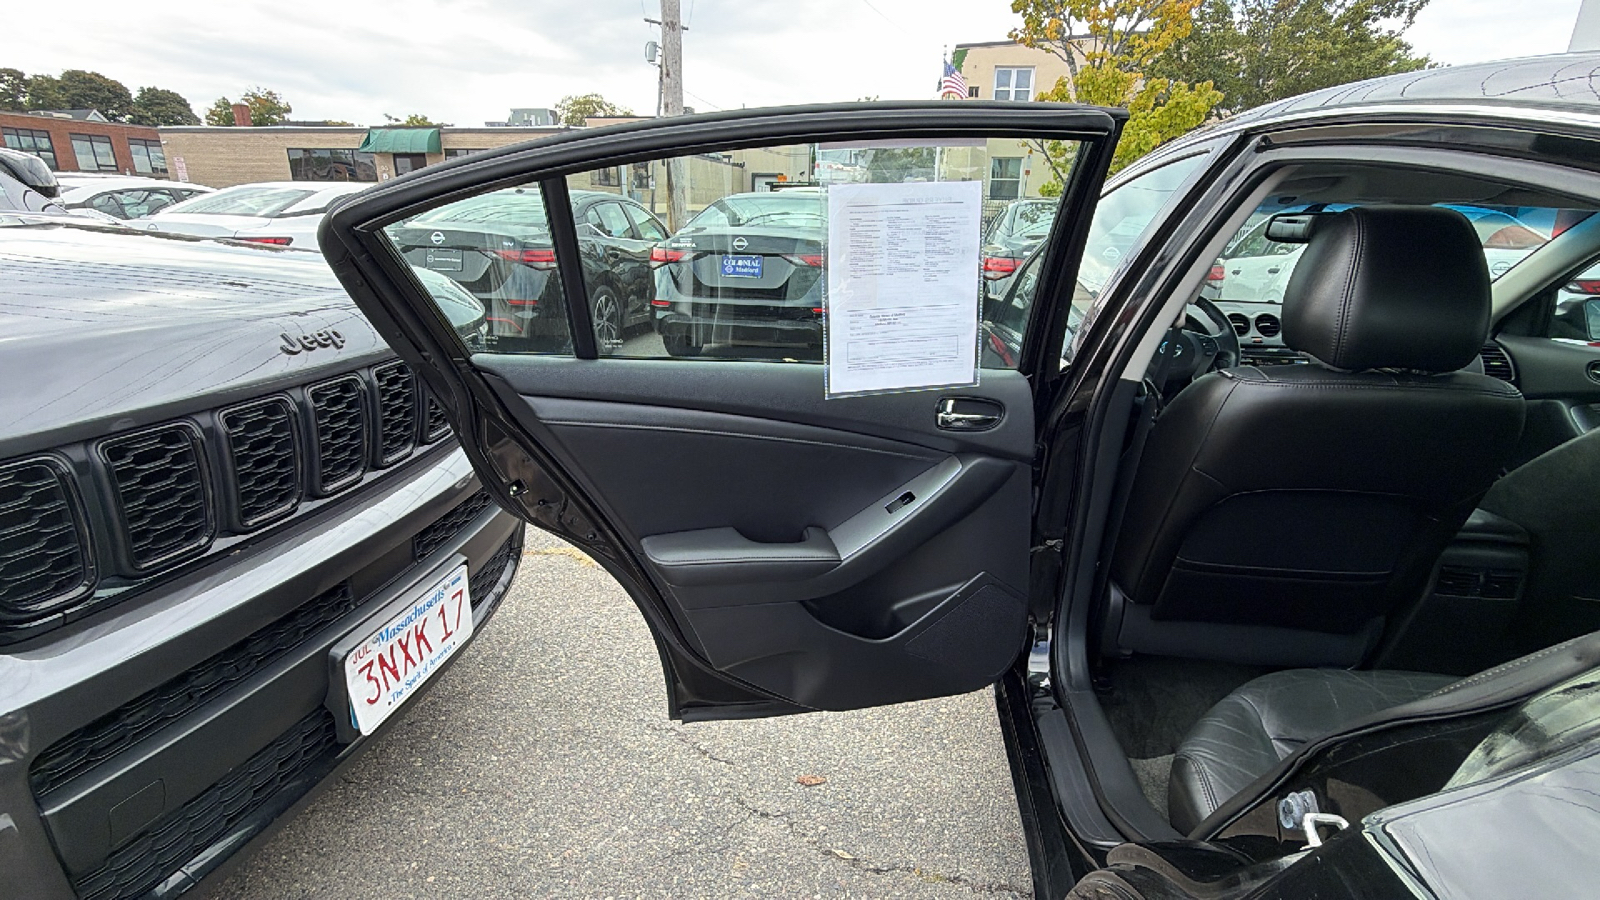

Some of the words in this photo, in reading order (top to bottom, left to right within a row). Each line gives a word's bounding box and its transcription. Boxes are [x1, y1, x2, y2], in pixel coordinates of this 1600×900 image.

[723, 258, 761, 267] COLONIAL
[279, 329, 346, 356] Jeep
[378, 589, 445, 647] Massachusetts
[352, 644, 372, 664] JUL
[358, 616, 433, 705] 3NXK
[437, 588, 464, 643] 17
[391, 687, 404, 702] The
[405, 671, 421, 690] Spirit
[422, 662, 429, 674] of
[429, 644, 452, 668] America
